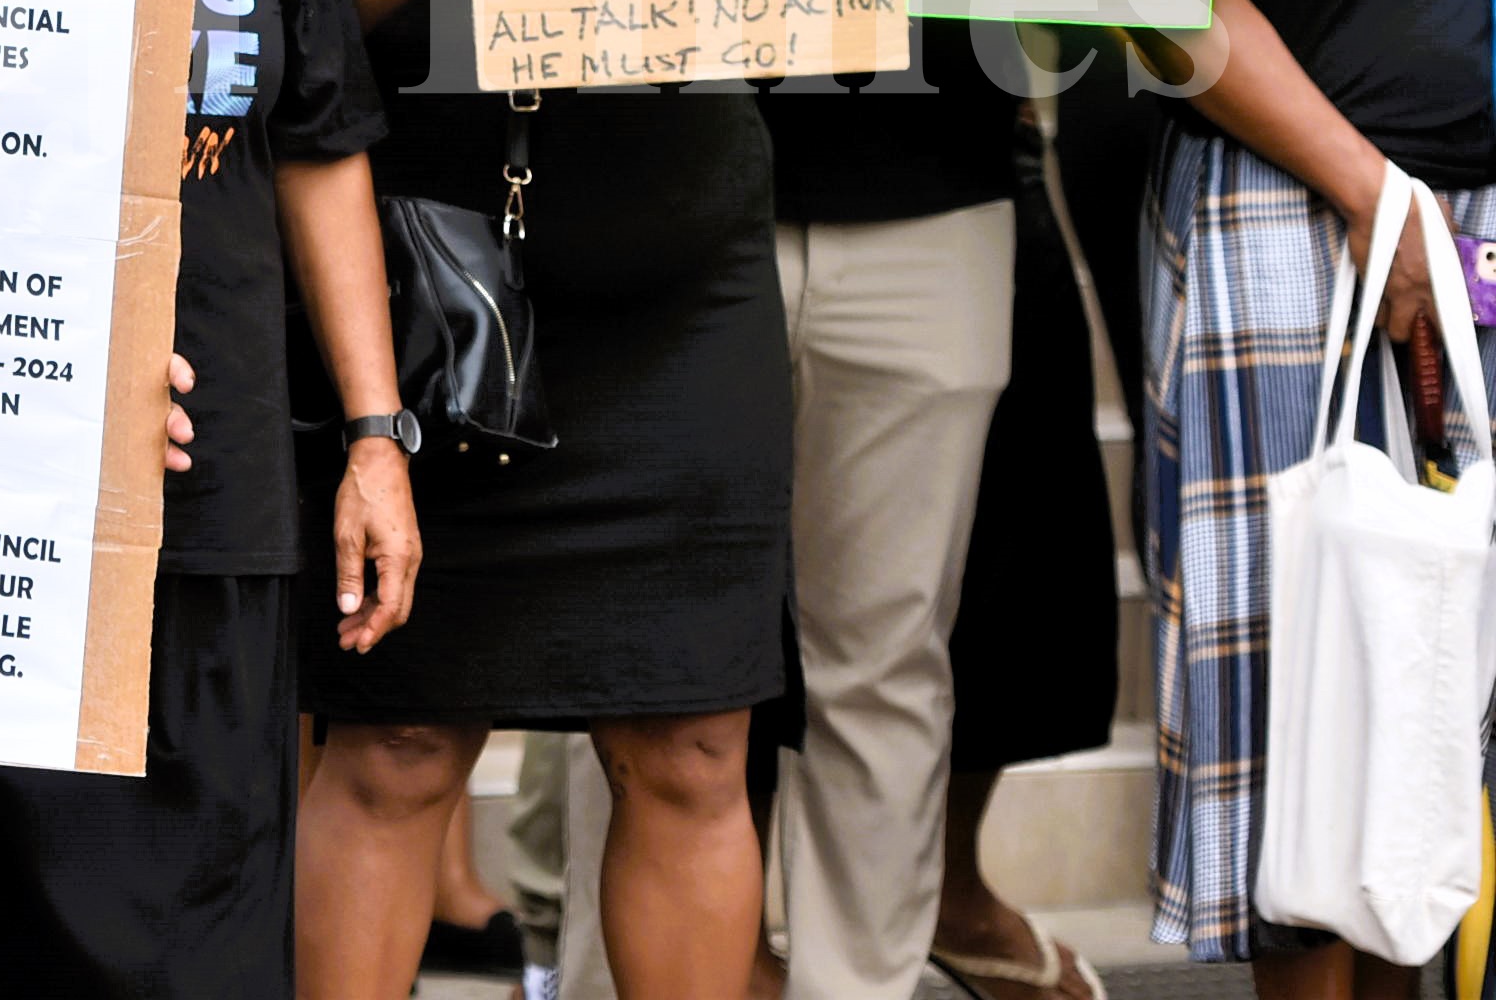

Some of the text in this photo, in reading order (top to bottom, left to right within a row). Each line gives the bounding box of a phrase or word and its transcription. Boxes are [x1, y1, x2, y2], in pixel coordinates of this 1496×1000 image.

[488, 11, 564, 51] ALL
[511, 32, 797, 84] HE MUST GO!
[26, 273, 63, 298] OF
[12, 356, 73, 383] 2024
